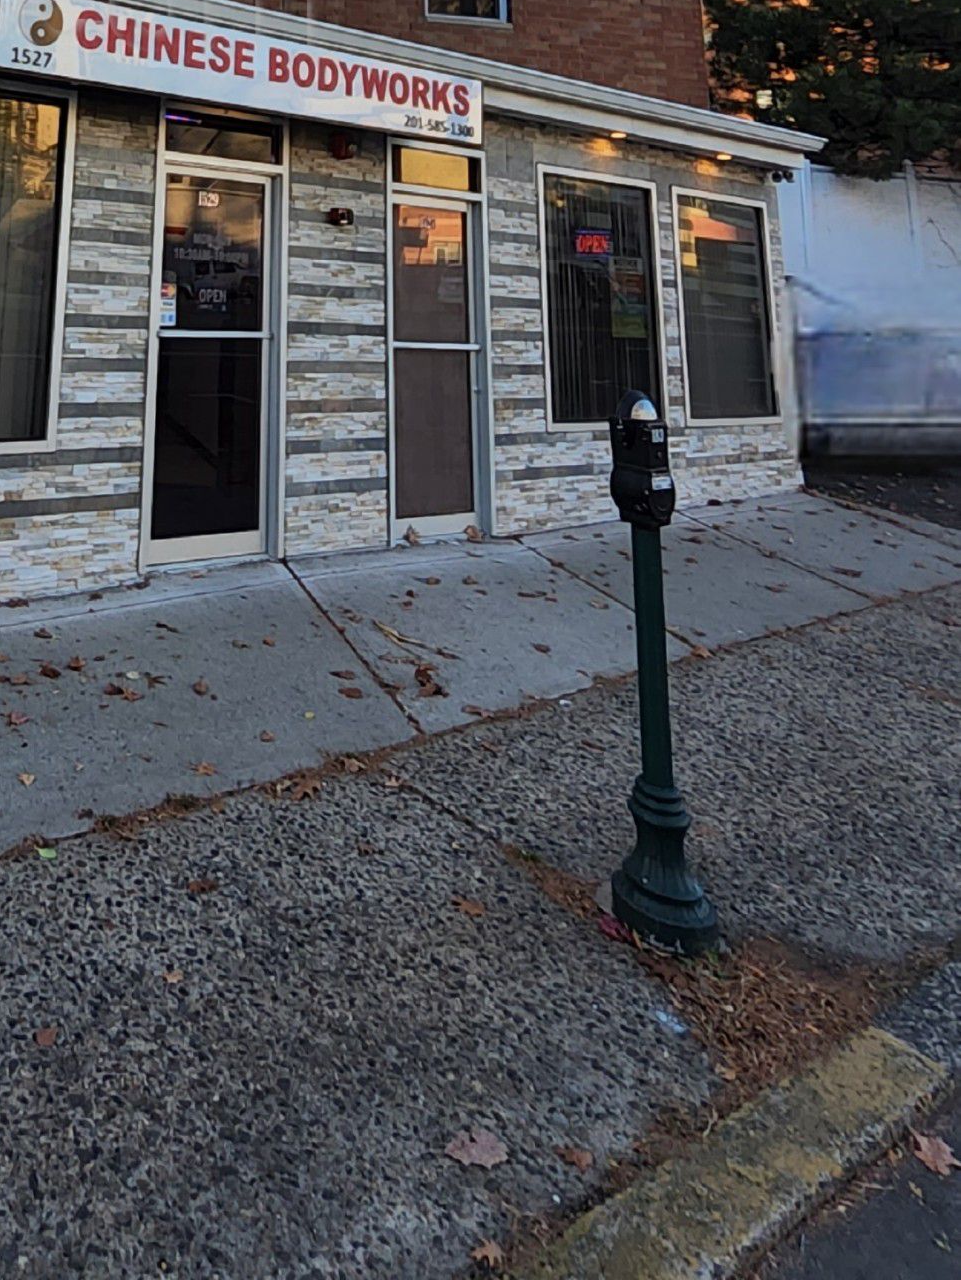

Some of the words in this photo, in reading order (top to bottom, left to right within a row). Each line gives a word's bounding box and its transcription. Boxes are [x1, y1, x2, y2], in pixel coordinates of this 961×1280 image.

[11, 45, 53, 69] 1527
[75, 9, 256, 78] CHINESE
[268, 47, 471, 116] BODYWORKS
[575, 234, 608, 253] OPEN
[198, 288, 228, 303] OPEN
